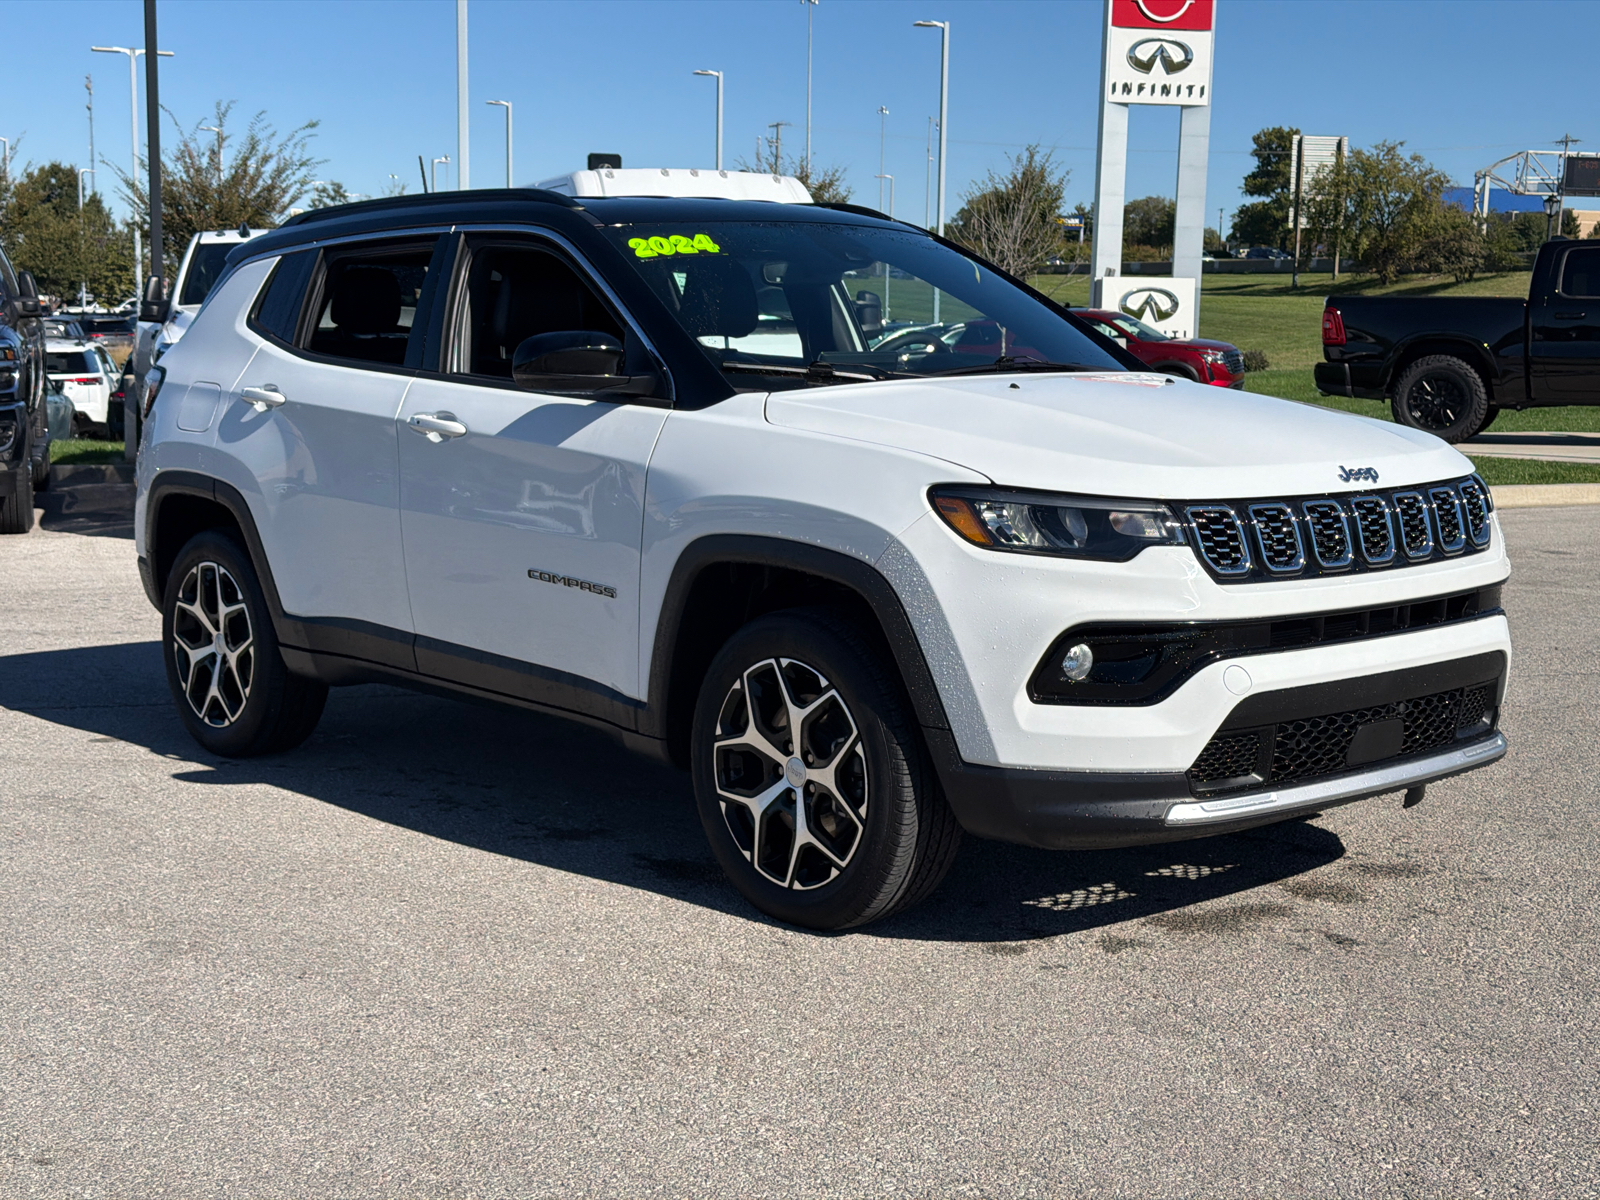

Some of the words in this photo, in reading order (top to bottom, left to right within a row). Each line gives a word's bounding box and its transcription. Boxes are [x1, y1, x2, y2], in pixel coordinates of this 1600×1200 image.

[1111, 81, 1205, 98] INFINITI
[628, 234, 720, 258] 2024
[1337, 464, 1379, 484] Jeep
[527, 568, 617, 599] COMPASS
